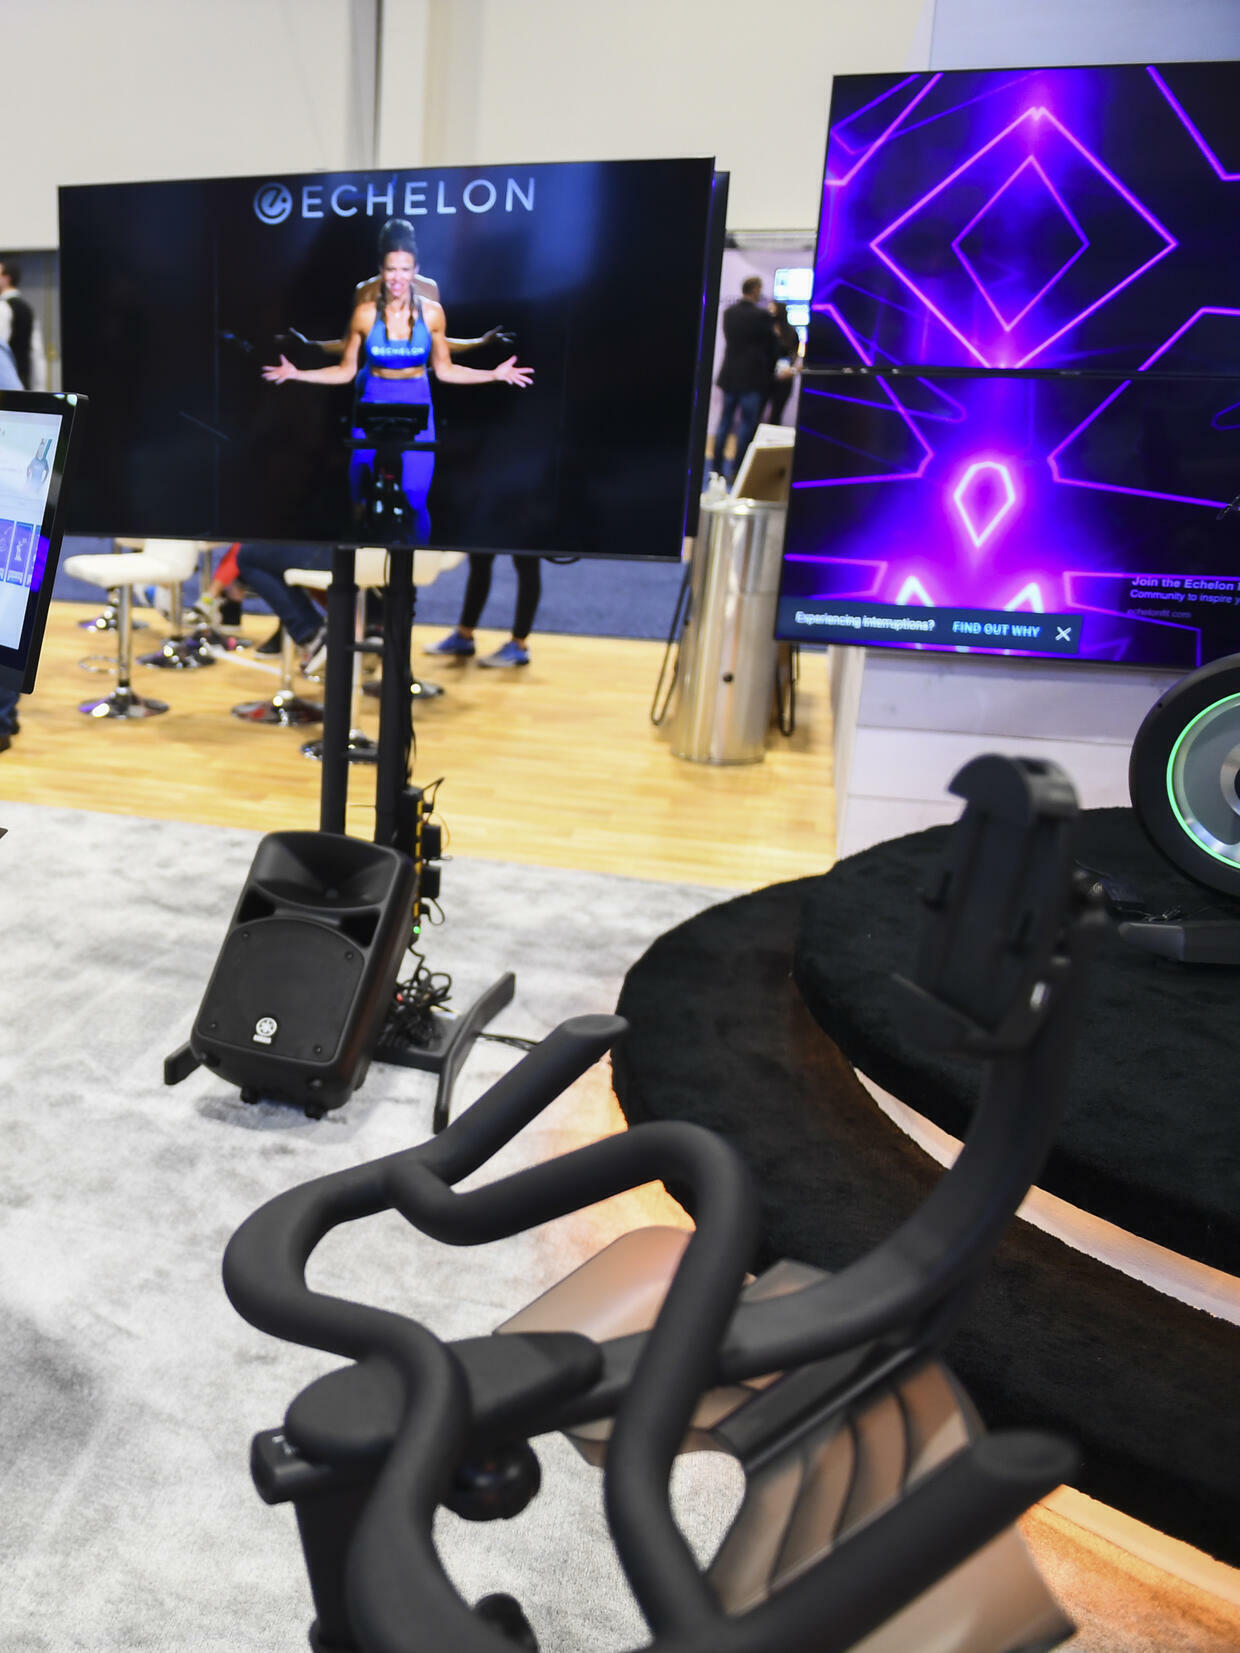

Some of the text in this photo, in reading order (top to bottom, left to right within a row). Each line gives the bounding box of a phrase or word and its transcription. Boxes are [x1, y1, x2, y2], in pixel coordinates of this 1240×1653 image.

[302, 178, 534, 218] ECHELON
[1131, 576, 1158, 587] Join
[1161, 578, 1181, 588] the
[1184, 579, 1234, 590] Echelon
[1130, 589, 1185, 602] Community
[1188, 593, 1197, 601] to
[1200, 594, 1232, 604] inspire
[795, 611, 1041, 638] Experiencing interruptions? FIND OUT WHY
